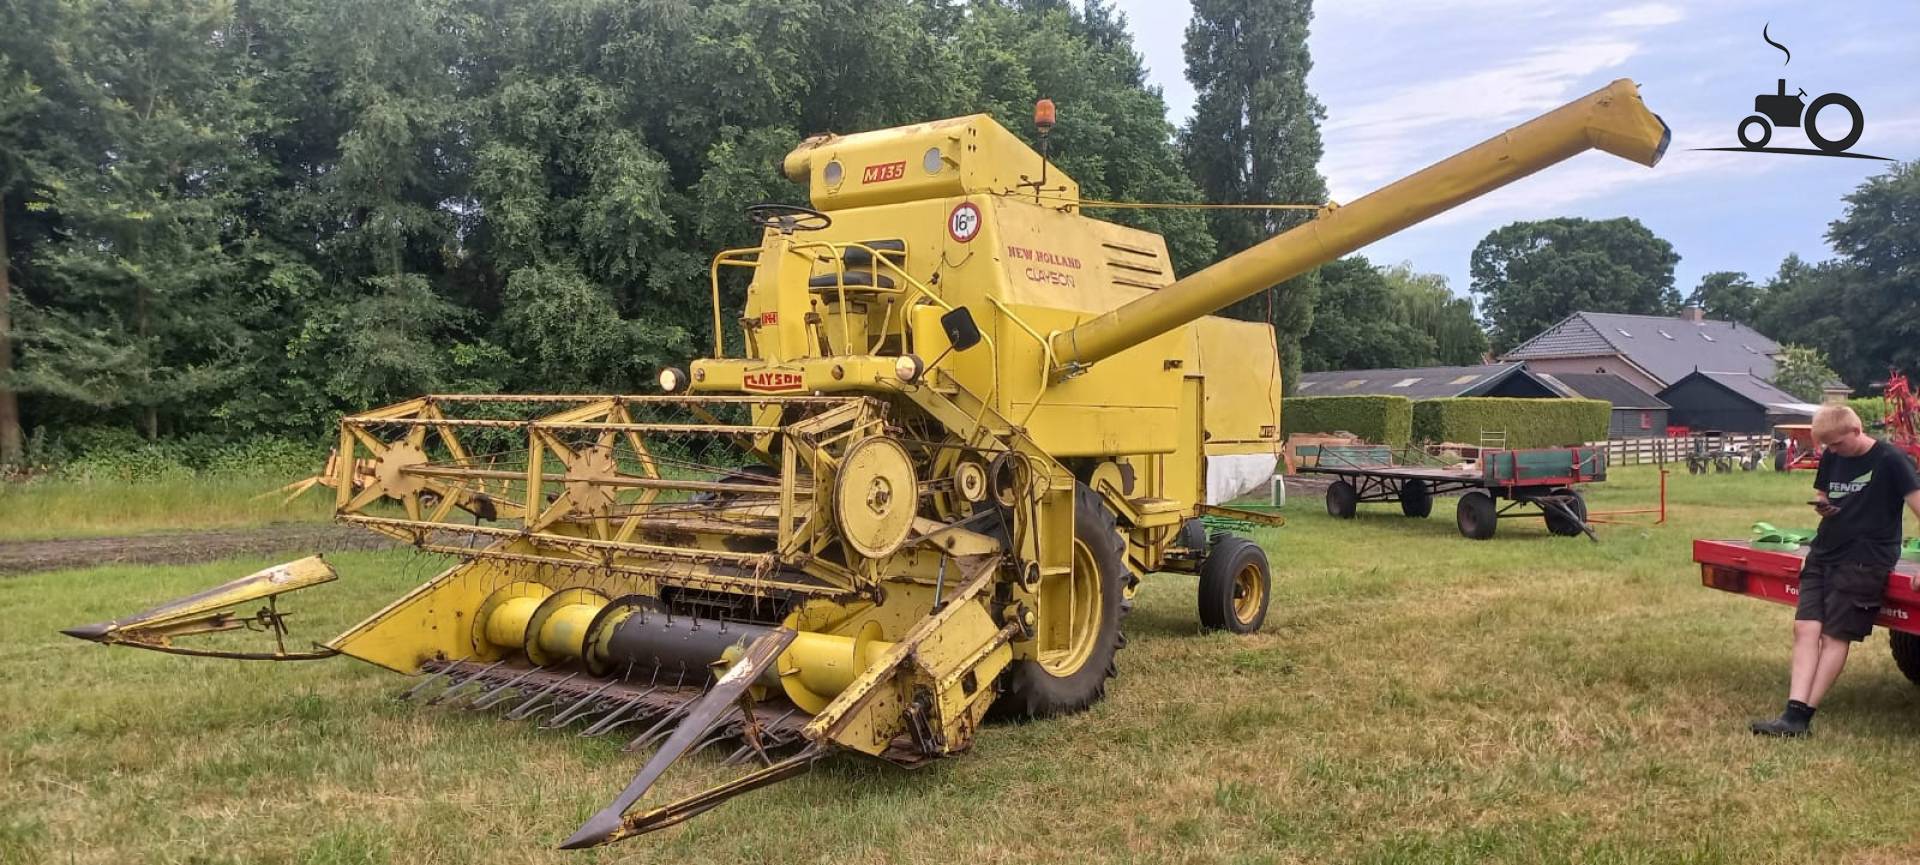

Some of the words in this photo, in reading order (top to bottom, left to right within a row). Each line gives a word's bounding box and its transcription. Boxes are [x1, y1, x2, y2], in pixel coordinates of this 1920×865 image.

[955, 214, 967, 231] 16
[1008, 246, 1033, 260] NEW
[1036, 250, 1082, 269] HOLLAND
[1025, 267, 1075, 288] CLAYSON
[744, 373, 802, 391] CLAYSON
